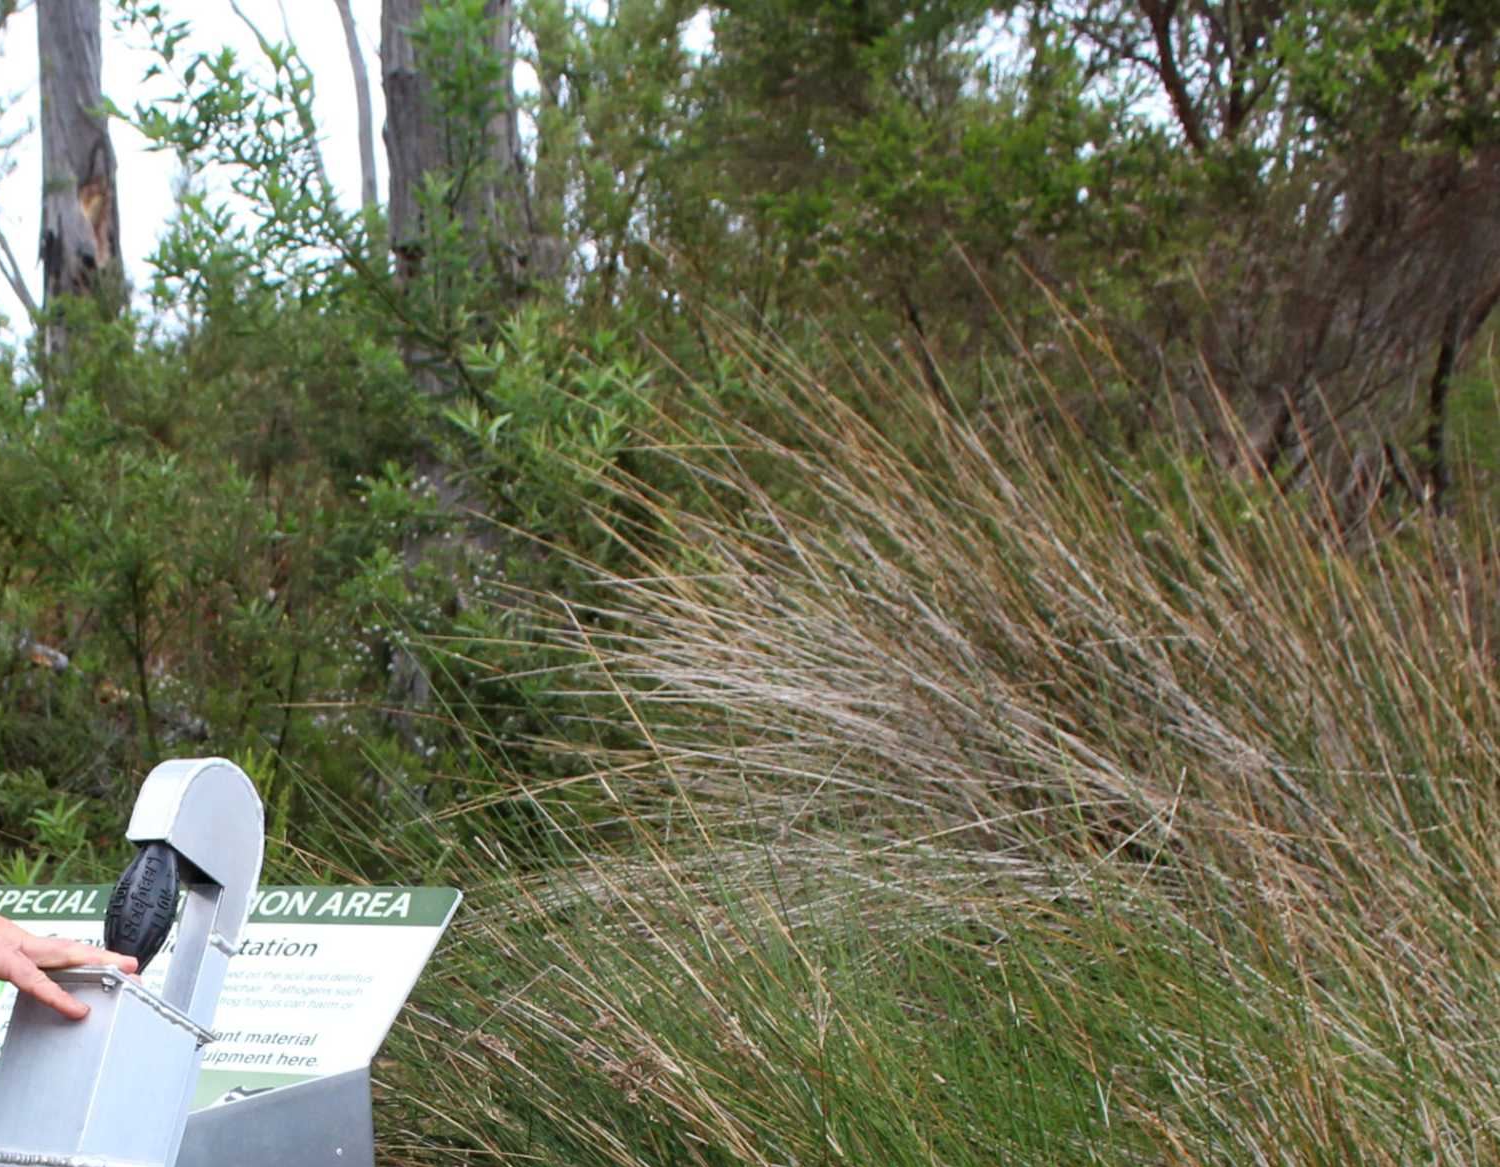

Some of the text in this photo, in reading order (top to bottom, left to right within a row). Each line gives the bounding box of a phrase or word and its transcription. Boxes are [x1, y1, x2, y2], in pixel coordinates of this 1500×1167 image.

[315, 891, 412, 918] AREA
[239, 937, 318, 957] tation
[284, 999, 306, 1009] can
[245, 1031, 319, 1047] material
[202, 1048, 274, 1066] uipment
